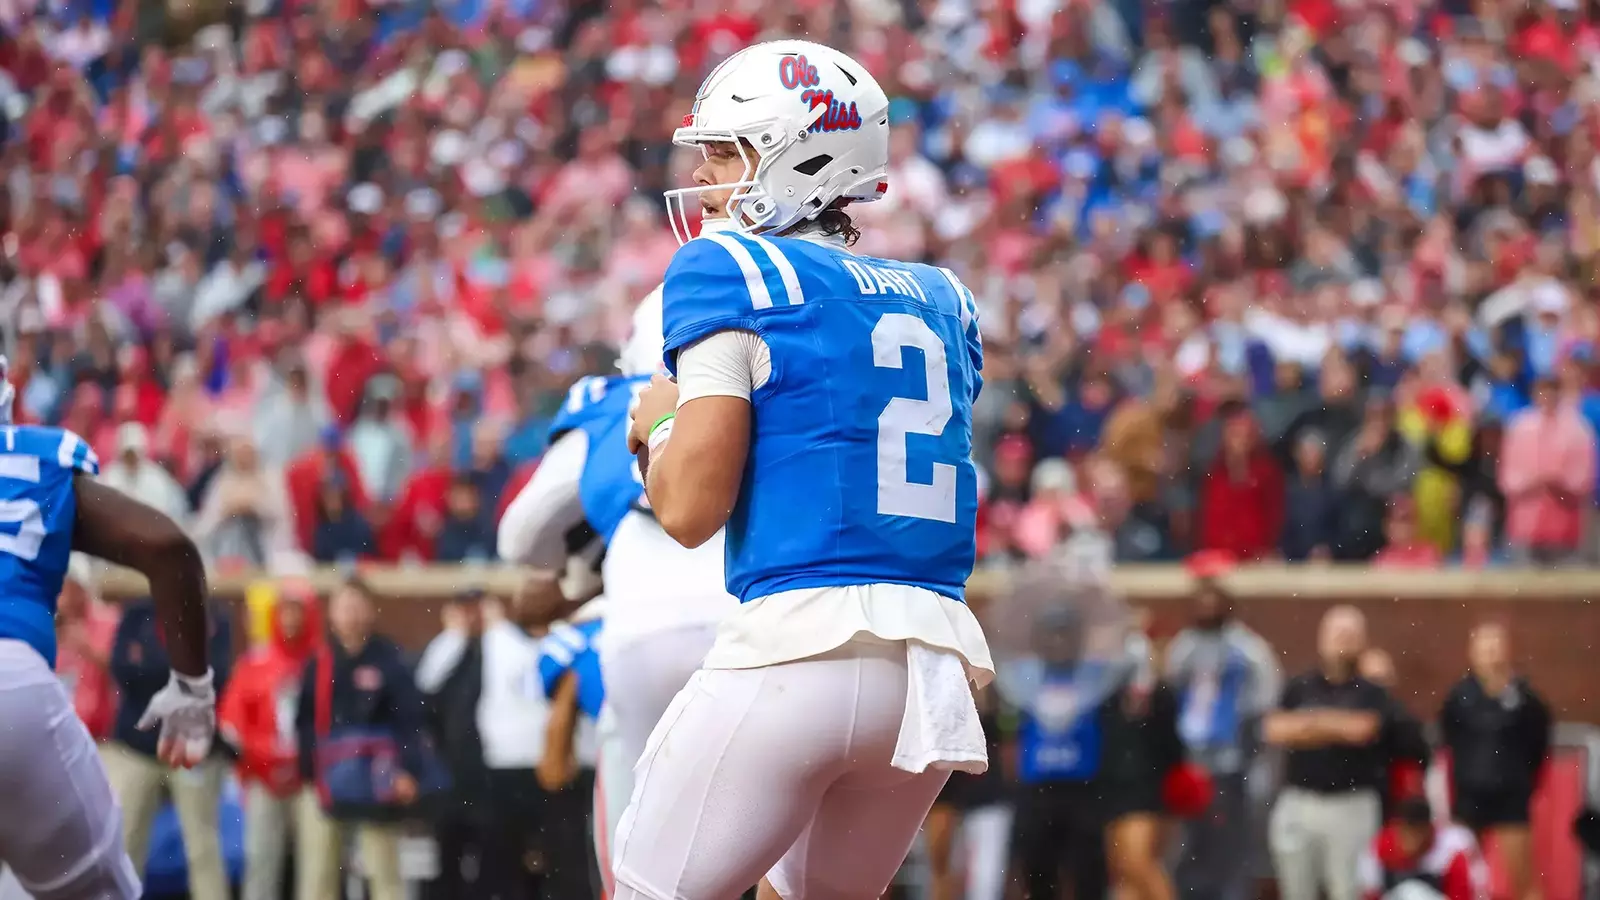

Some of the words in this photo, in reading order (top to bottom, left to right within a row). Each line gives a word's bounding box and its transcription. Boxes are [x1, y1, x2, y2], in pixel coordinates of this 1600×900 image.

[779, 55, 820, 89] Ole
[801, 89, 862, 133] Miss
[841, 260, 927, 303] DART
[871, 313, 956, 524] 2
